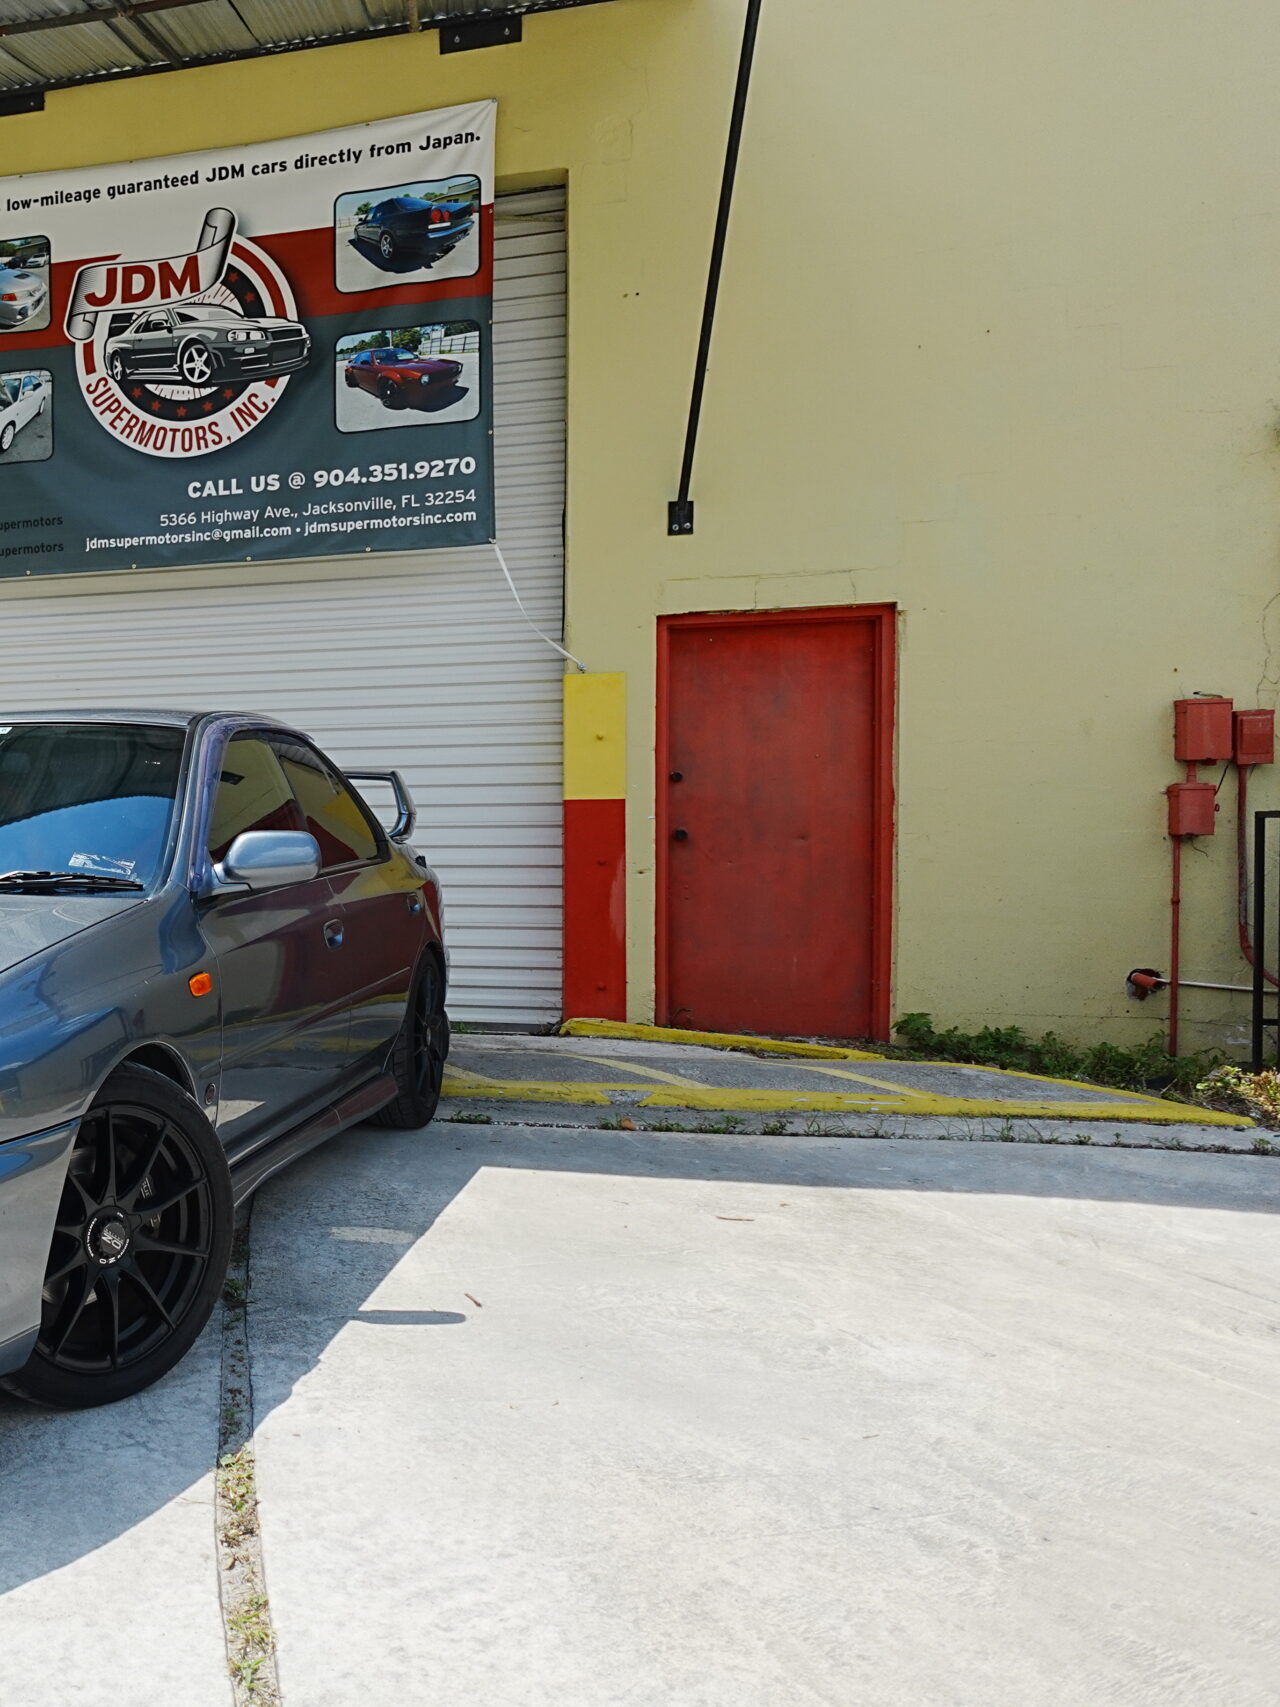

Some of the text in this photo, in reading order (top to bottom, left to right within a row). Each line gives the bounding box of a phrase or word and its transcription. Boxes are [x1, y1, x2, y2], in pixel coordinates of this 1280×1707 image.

[6, 187, 101, 212] low-mileage
[106, 170, 200, 200] guaranteed
[205, 163, 246, 183] JDM
[251, 158, 288, 177] cars
[293, 147, 363, 171] directly
[369, 140, 412, 158] from
[418, 131, 481, 151] Japan.
[84, 254, 201, 307] JDM
[85, 376, 276, 453] SUPERMOTORS, INC.
[187, 456, 477, 499] CALL US @ 904.351.9270
[85, 510, 477, 552] jdmsupermotorsinc@gmail.com jdmsupermotorsinc.com
[159, 489, 477, 527] 5366 Highway Ave., Jacksonville, FL 32254
